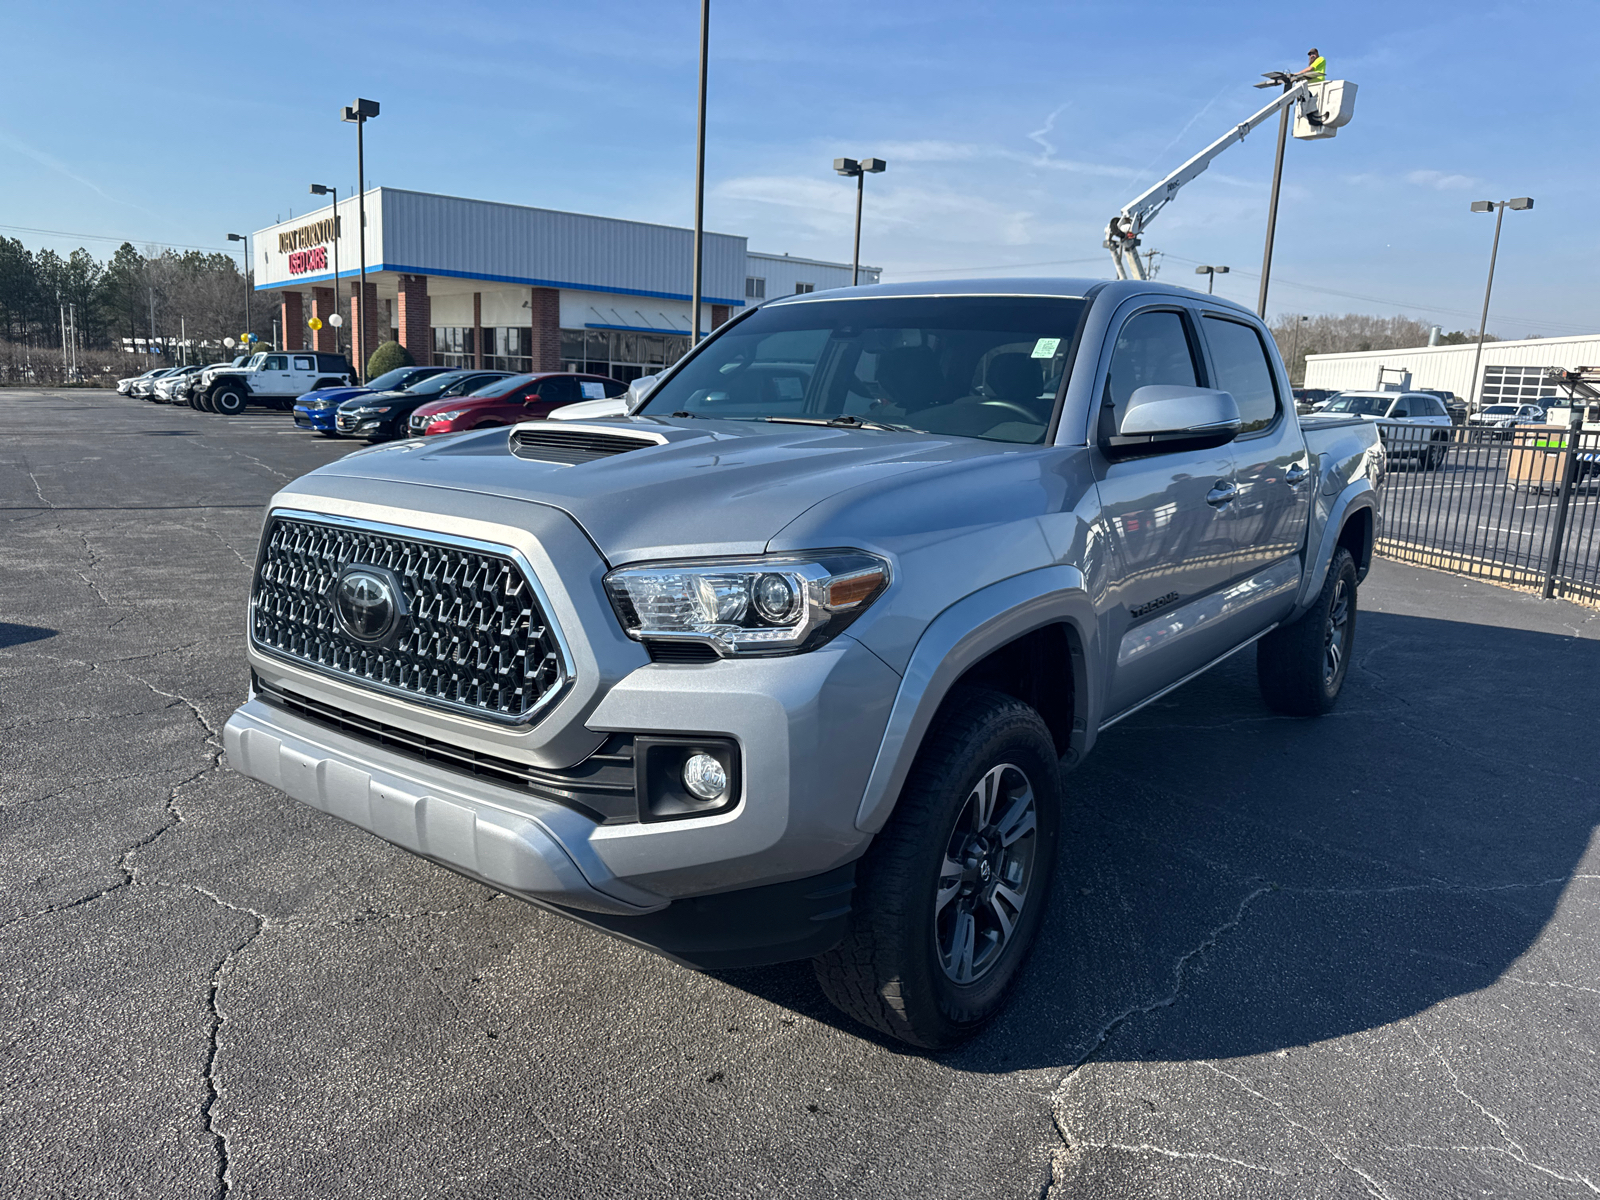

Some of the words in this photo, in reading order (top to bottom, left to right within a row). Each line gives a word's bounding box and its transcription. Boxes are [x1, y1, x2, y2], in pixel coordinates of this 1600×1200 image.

[278, 230, 297, 254] JOHN
[288, 252, 306, 274] USED
[306, 246, 327, 270] CARS
[1130, 591, 1179, 618] TACOMA
